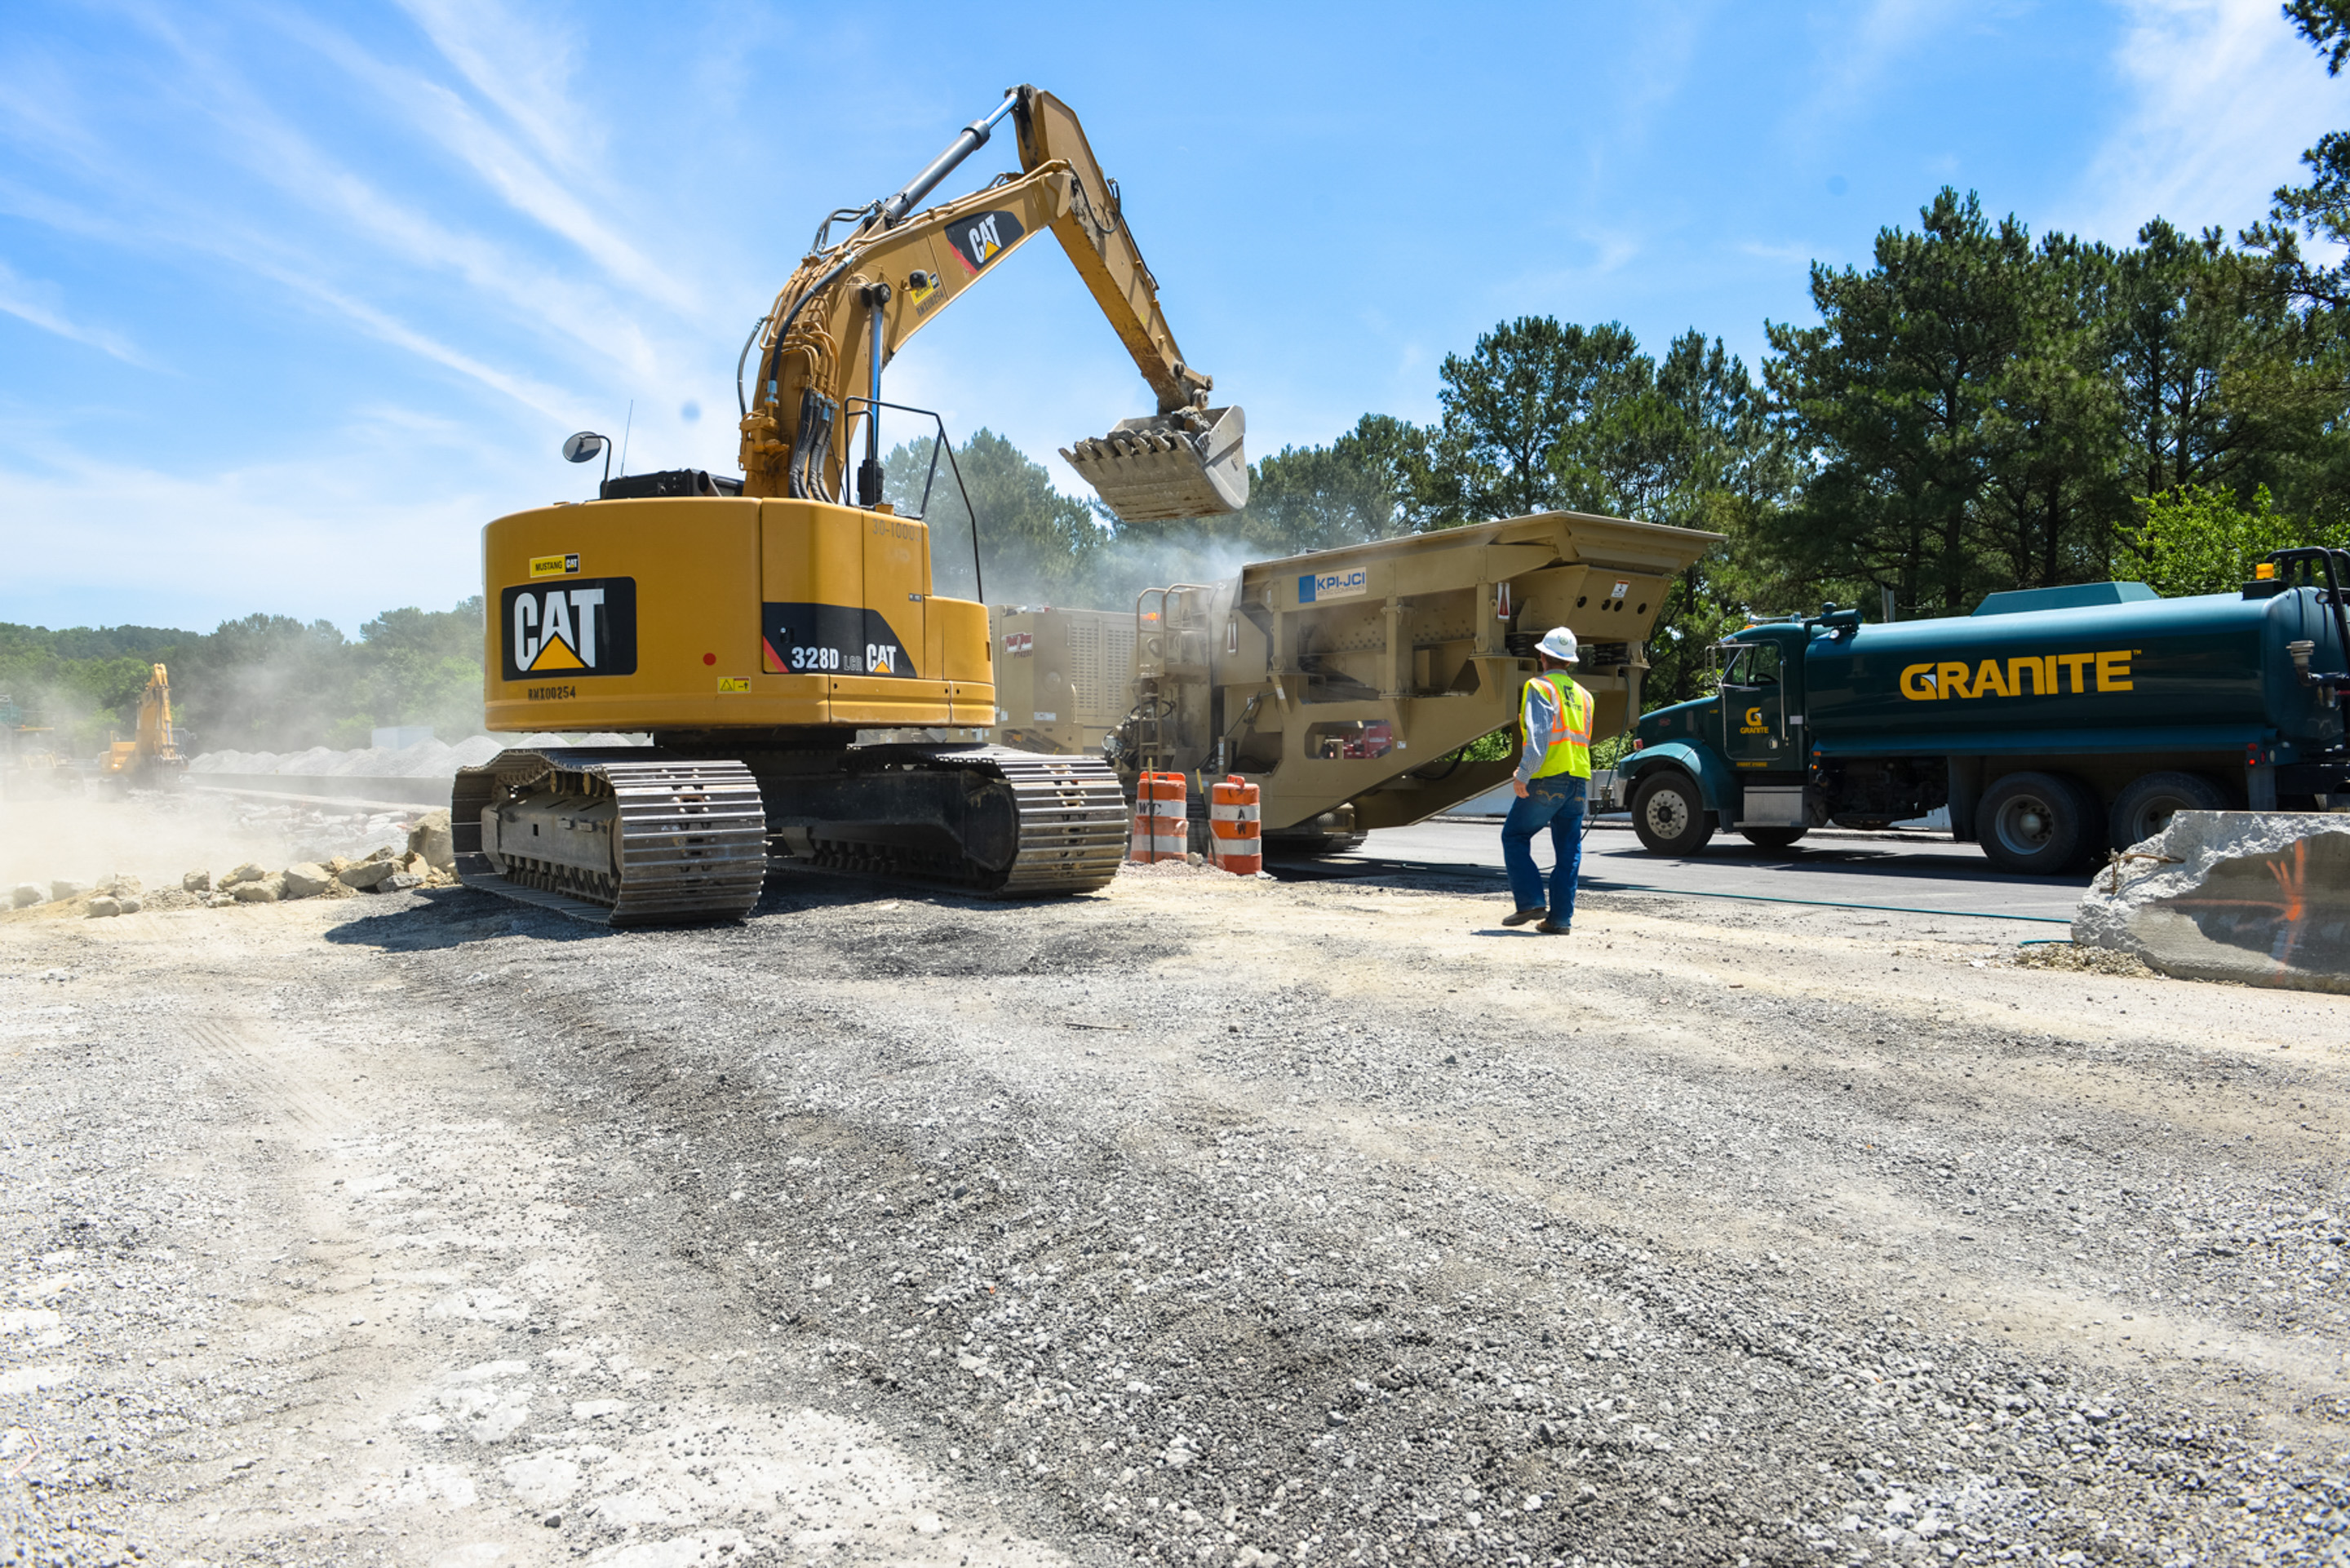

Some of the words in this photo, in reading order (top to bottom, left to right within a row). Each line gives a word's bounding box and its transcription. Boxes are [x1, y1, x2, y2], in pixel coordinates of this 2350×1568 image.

[969, 214, 1002, 264] CAT
[535, 560, 563, 572] MUSTANG
[565, 558, 578, 569] CAT
[1316, 572, 1366, 591] KPI-JCI
[514, 588, 605, 672] CAT
[791, 646, 840, 670] 328D
[866, 643, 898, 674] CAT
[1900, 650, 2134, 701] GRANITE
[528, 686, 577, 702] RMX00254
[1745, 706, 1762, 726] G
[1739, 726, 1769, 734] GRANITE
